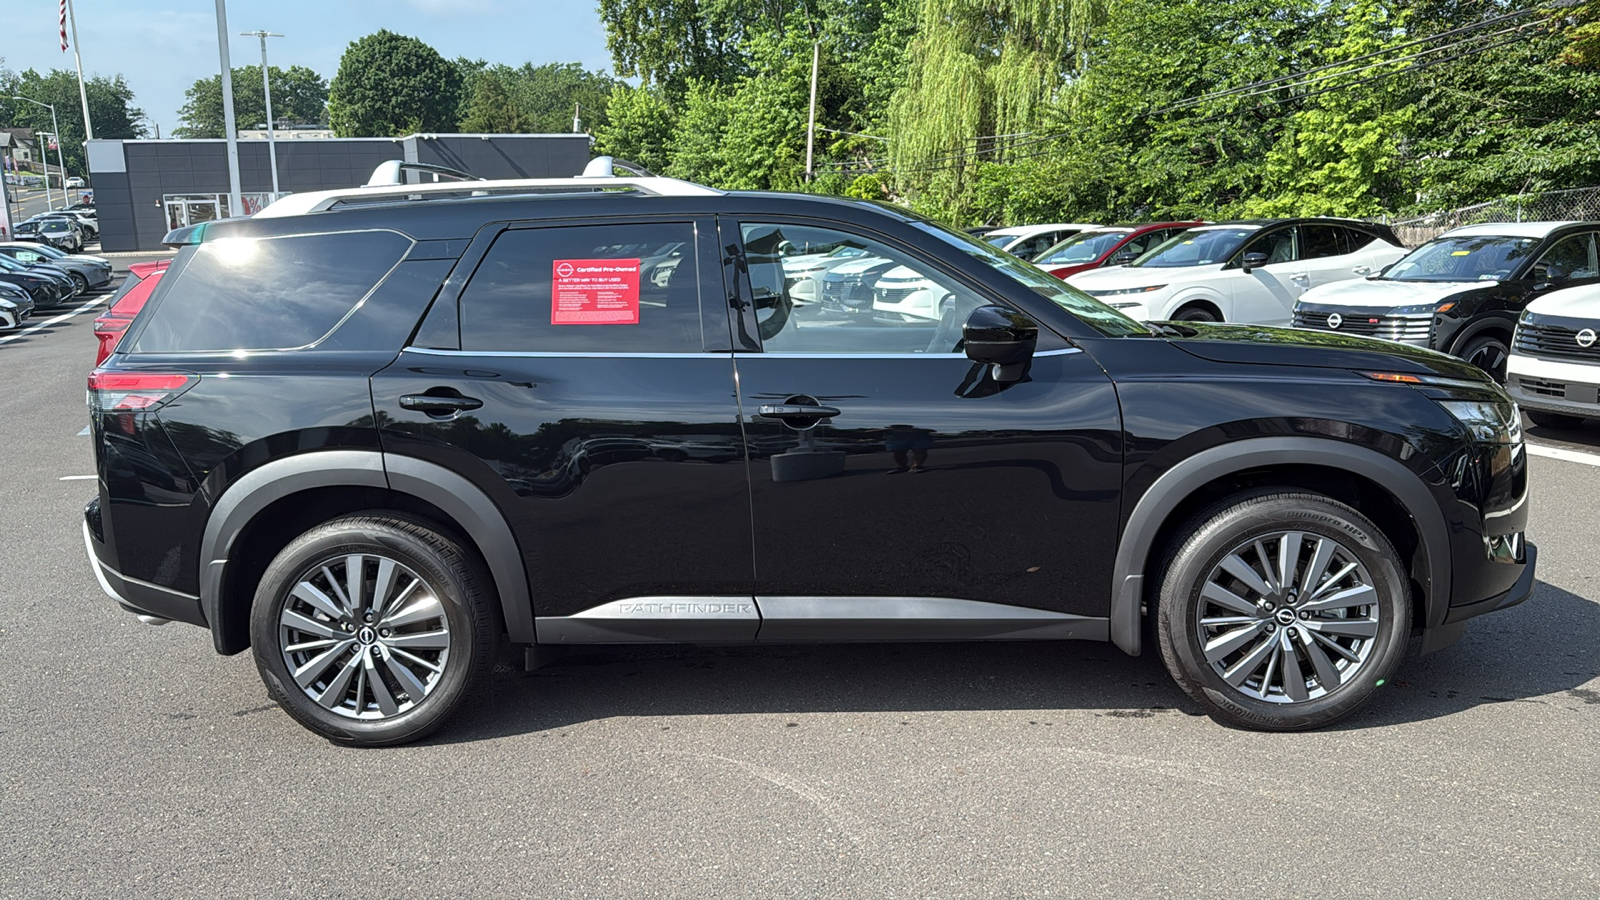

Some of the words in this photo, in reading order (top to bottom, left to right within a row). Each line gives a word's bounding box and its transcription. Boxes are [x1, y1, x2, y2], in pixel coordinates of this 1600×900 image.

[1286, 511, 1342, 526] Dynapro
[1343, 524, 1368, 542] HP2
[619, 603, 751, 614] PATHFINDER
